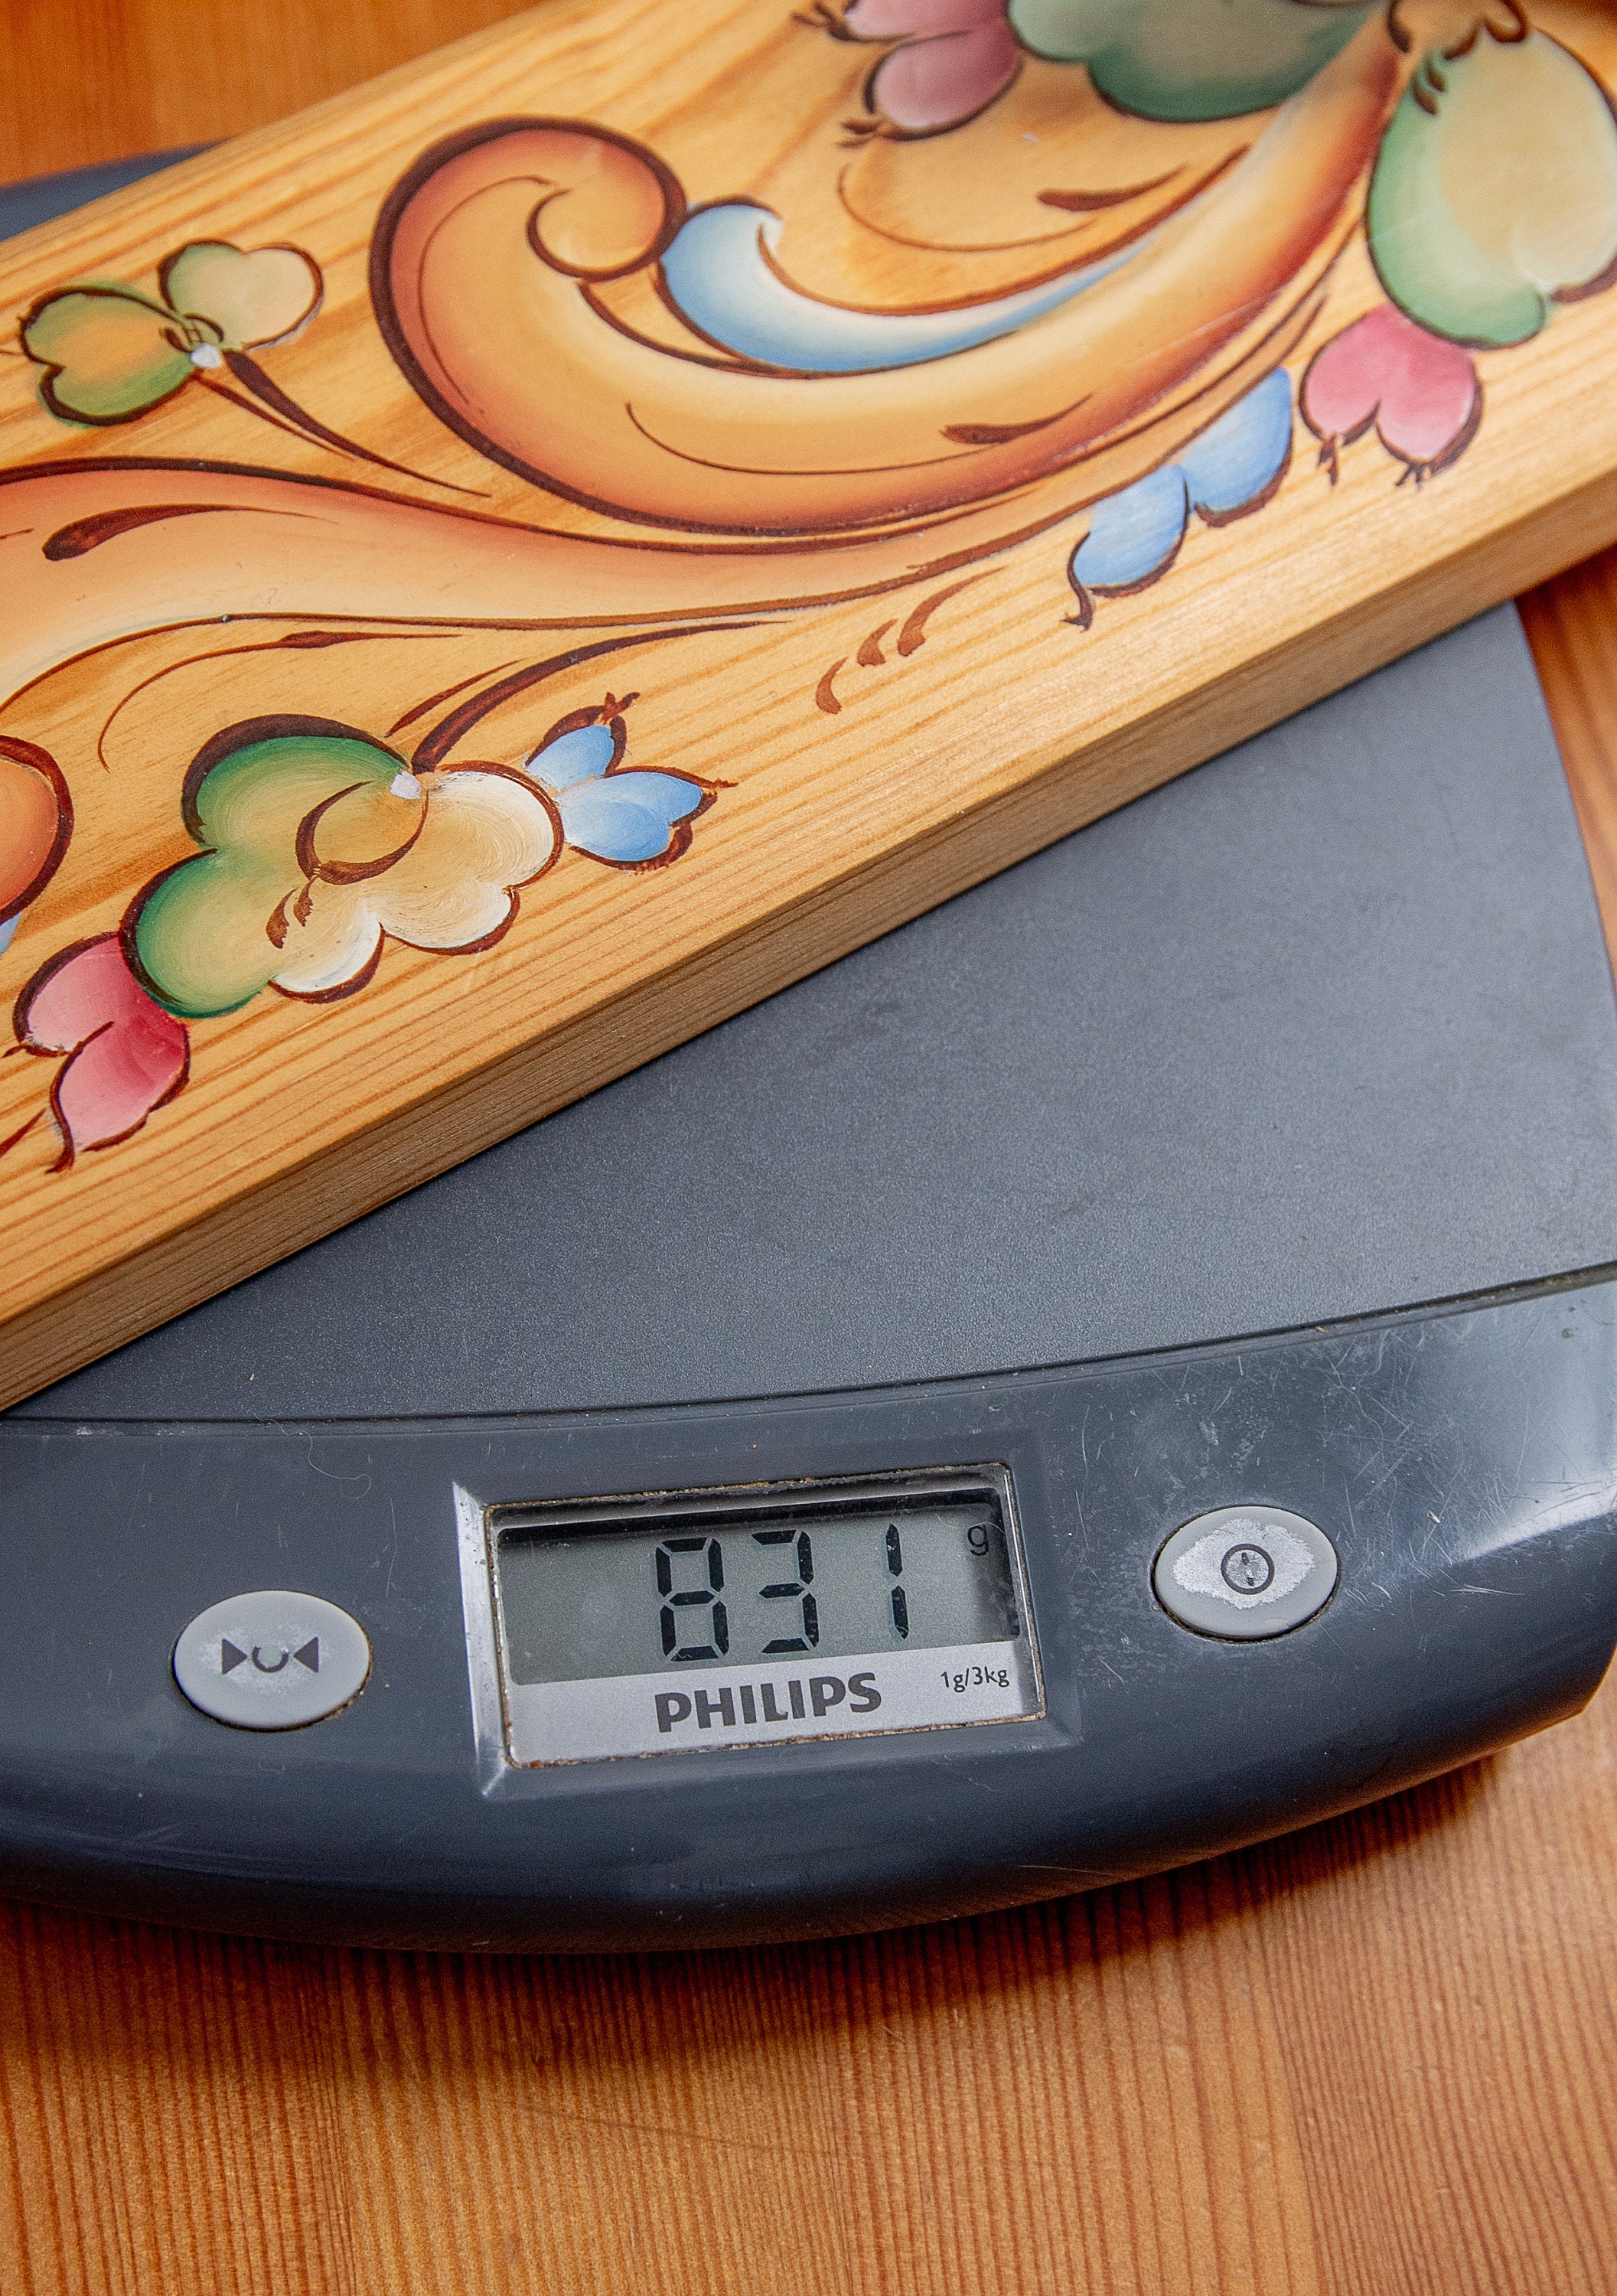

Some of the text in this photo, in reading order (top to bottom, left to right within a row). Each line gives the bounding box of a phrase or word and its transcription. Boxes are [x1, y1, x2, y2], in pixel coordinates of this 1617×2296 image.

[655, 1523, 989, 1662] 831 g
[654, 1671, 882, 1733] PHILIPS
[941, 1666, 1010, 1693] 1g/3kg
